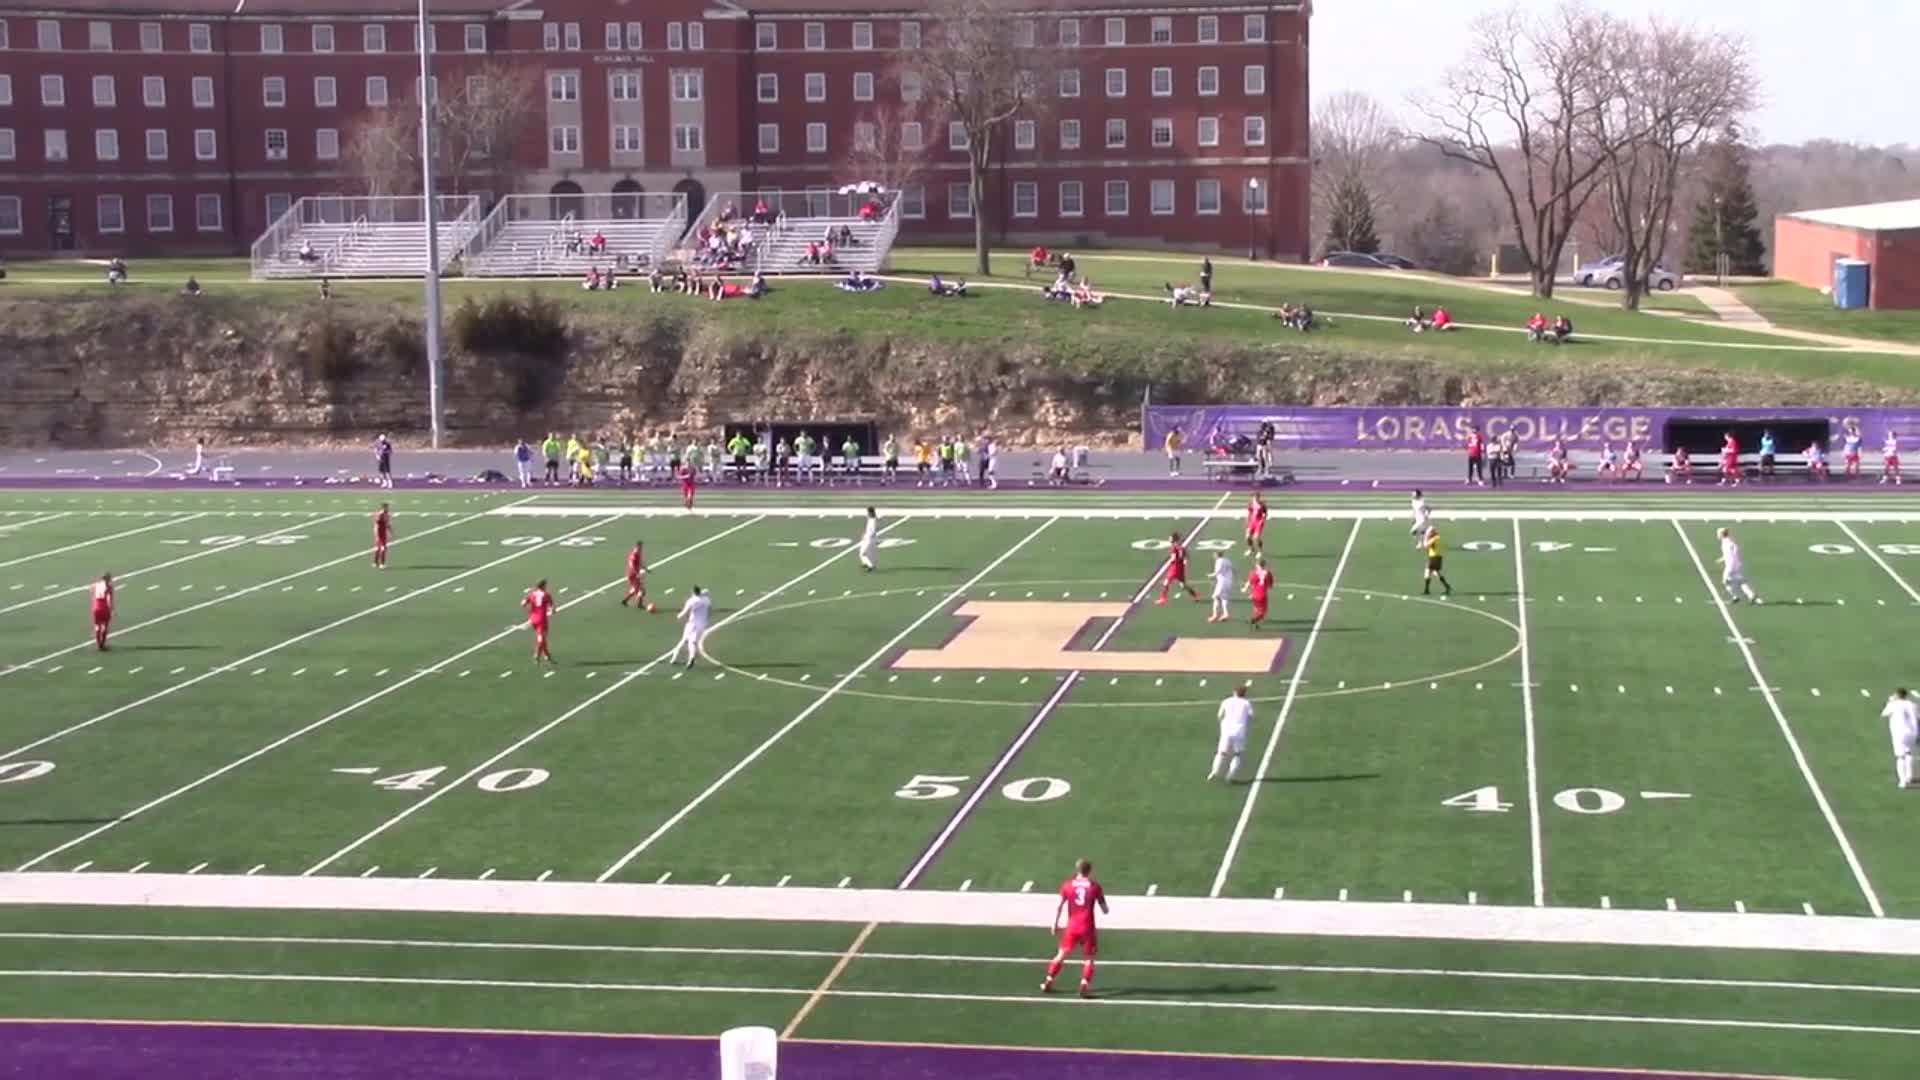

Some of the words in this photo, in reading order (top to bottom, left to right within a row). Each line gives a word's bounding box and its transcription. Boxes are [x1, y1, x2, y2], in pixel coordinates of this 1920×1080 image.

[1357, 416, 1472, 441] LORAS
[1486, 416, 1651, 441] COLLEGE
[1074, 886, 1087, 906] 3
